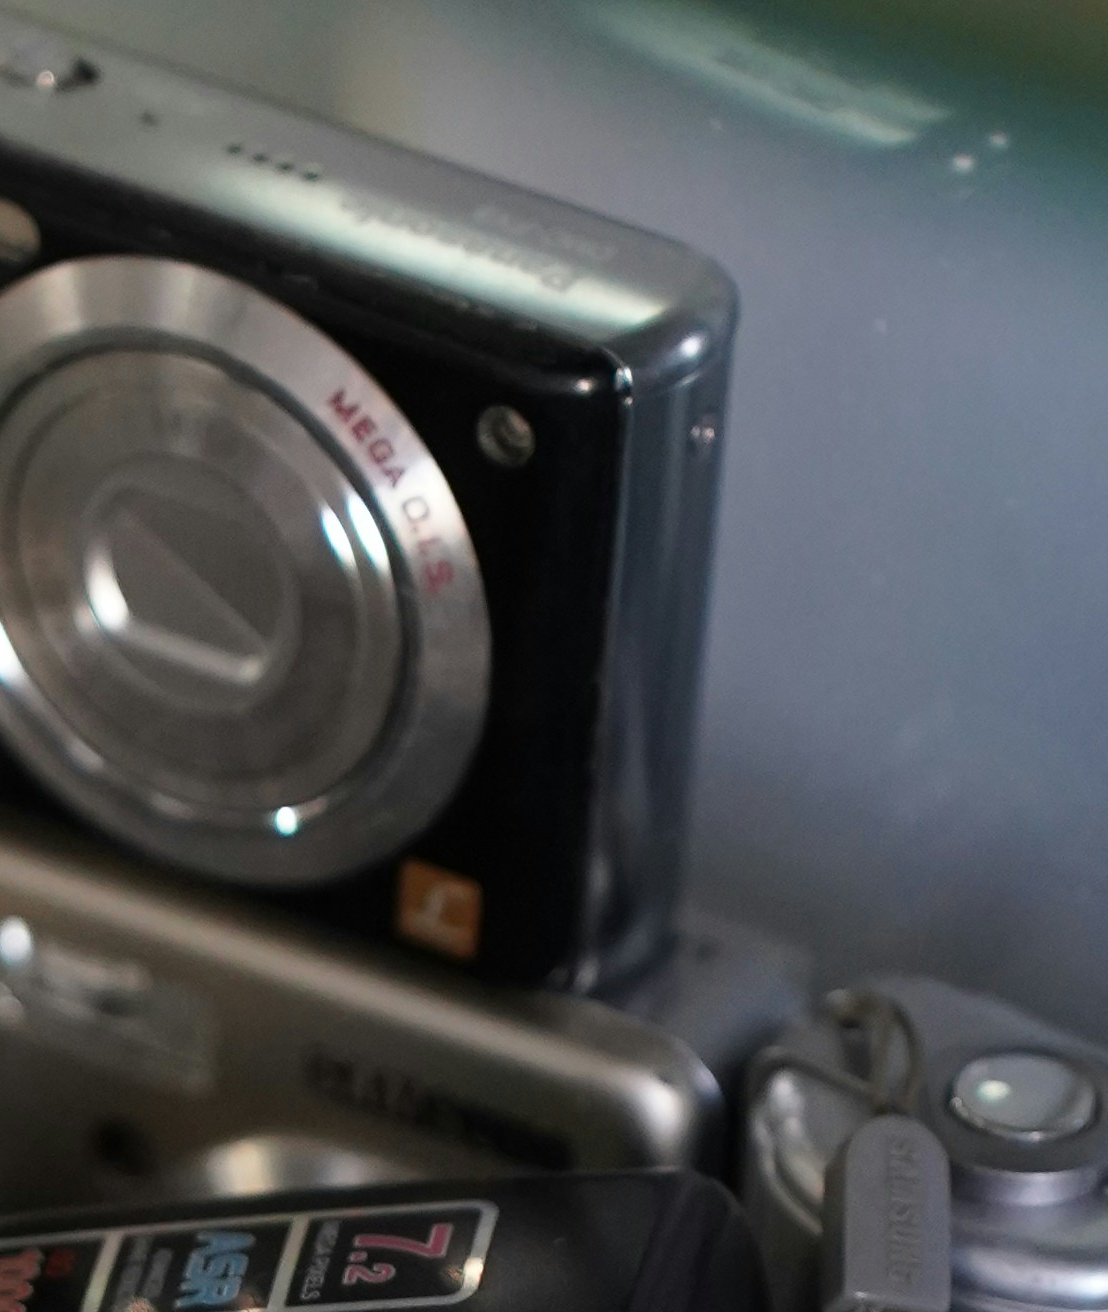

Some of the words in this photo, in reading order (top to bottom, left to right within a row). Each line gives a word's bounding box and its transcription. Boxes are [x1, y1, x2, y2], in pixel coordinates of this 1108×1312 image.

[328, 390, 405, 487] MEGA
[174, 1228, 256, 1309] ASR
[342, 1222, 454, 1288] 7.2
